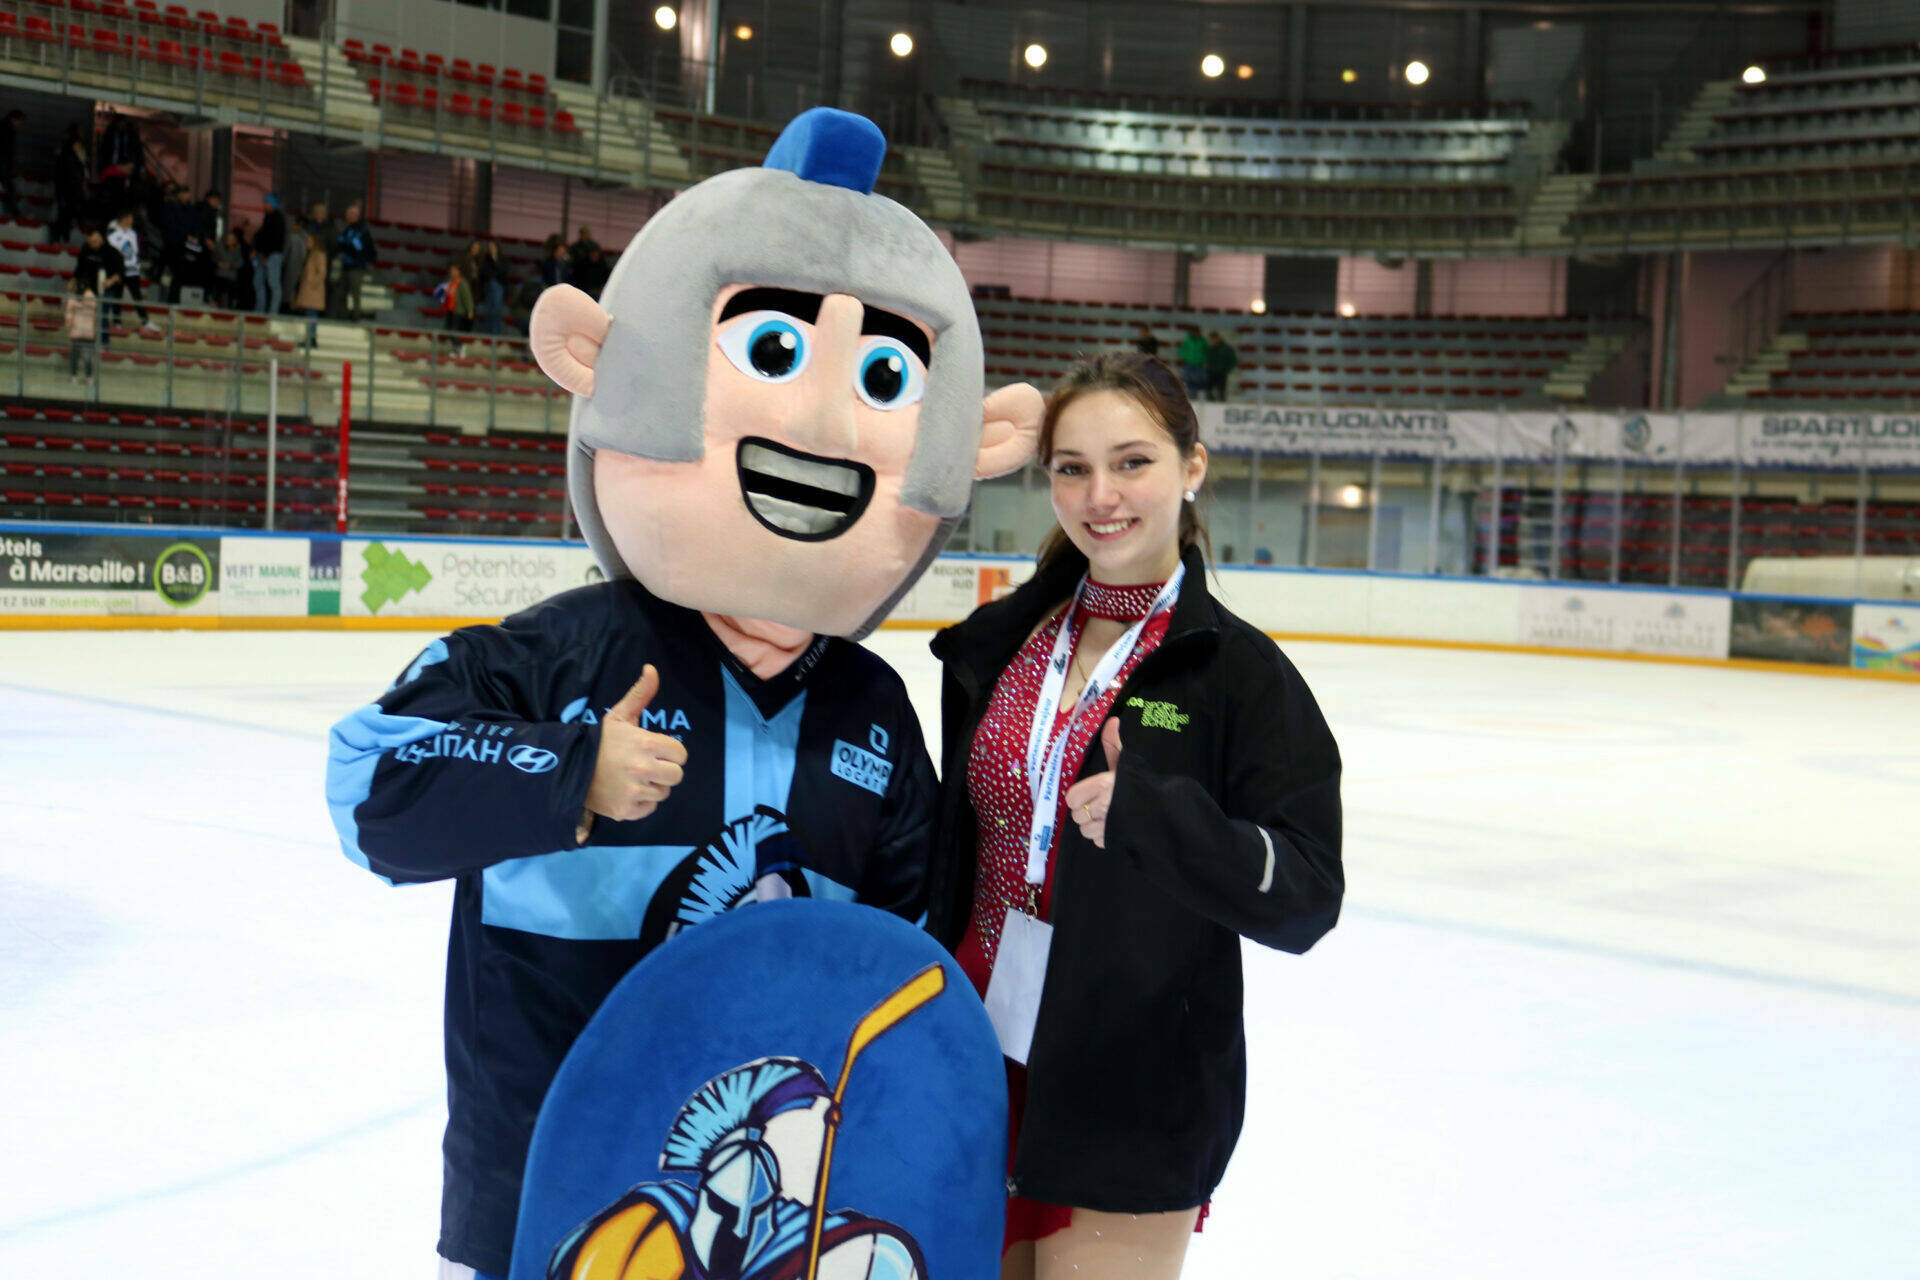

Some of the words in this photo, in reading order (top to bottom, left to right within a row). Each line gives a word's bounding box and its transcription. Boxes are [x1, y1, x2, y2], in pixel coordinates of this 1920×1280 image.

[9, 559, 26, 581] à
[162, 563, 204, 584] B&B
[226, 565, 254, 578] VERT
[258, 565, 301, 579] MARINE
[953, 578, 974, 590] SUD
[22, 597, 46, 606] SUR
